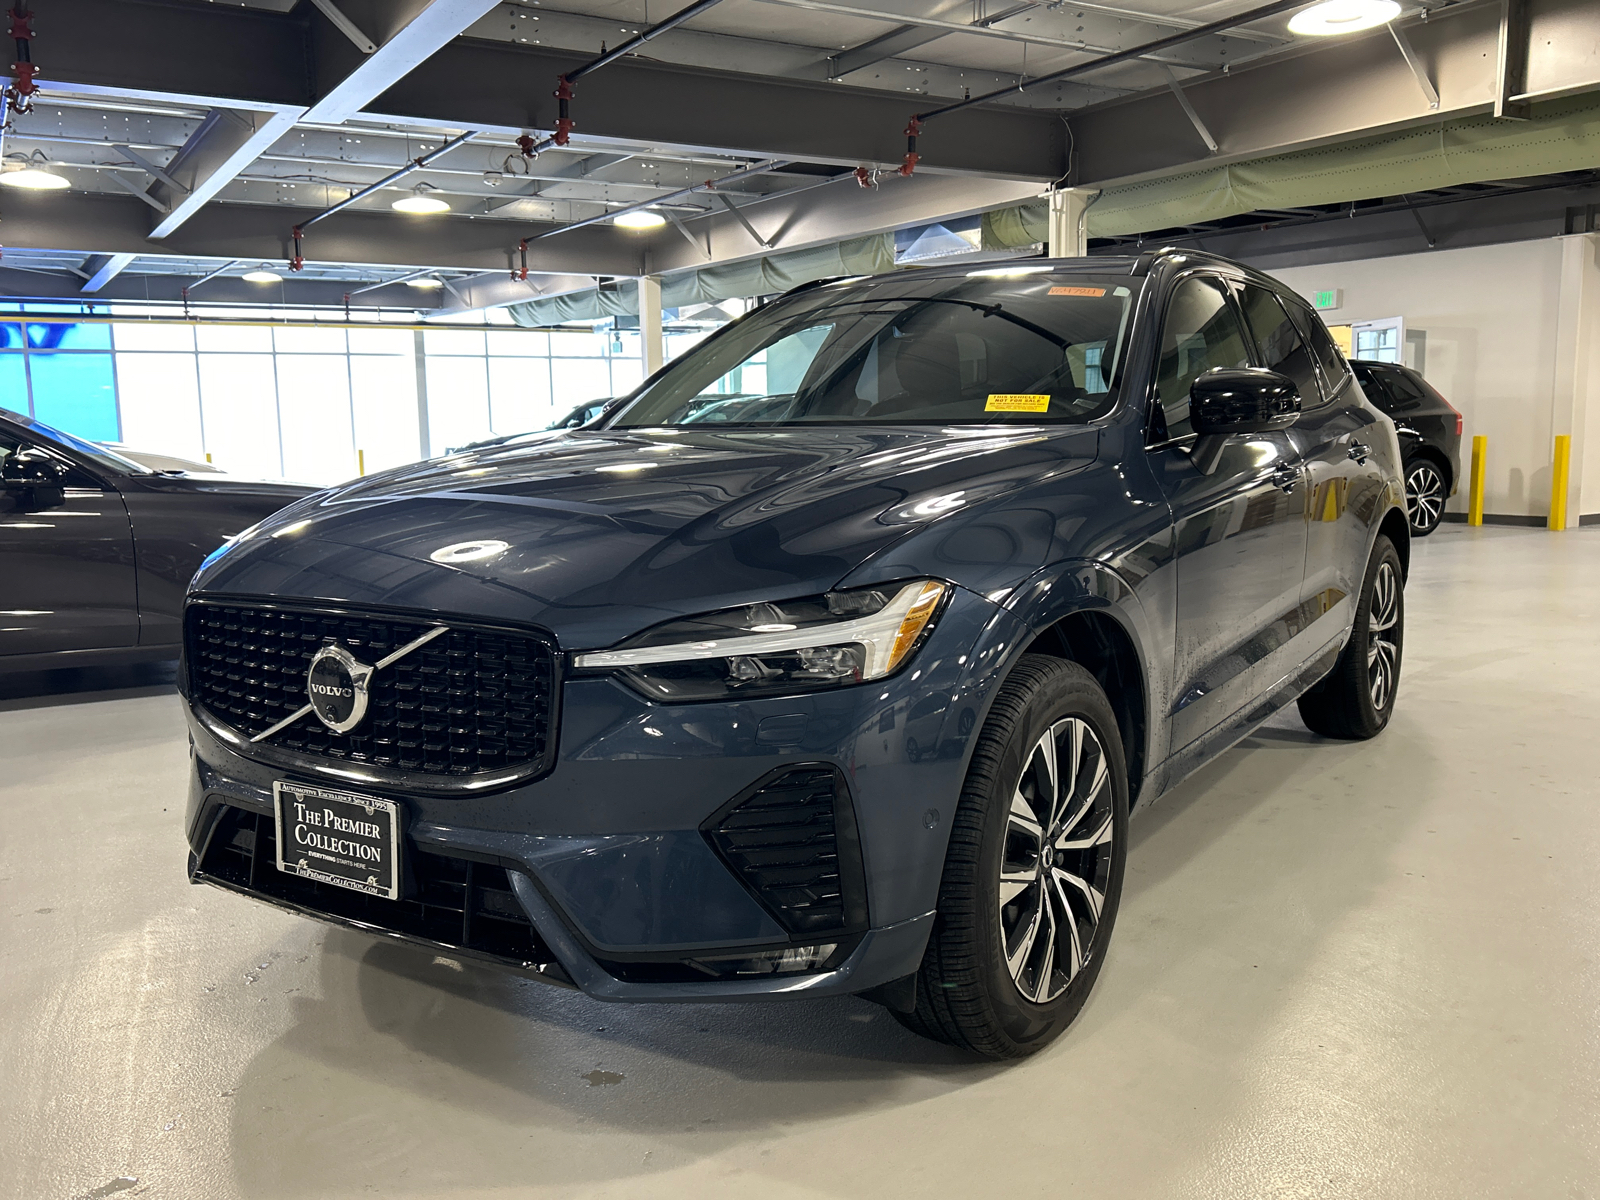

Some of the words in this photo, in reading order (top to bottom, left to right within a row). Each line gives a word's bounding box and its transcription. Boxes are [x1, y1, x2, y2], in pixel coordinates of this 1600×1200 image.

[1316, 291, 1334, 308] EXIT
[311, 683, 353, 698] VOLVO
[282, 784, 317, 796] AUTOMOTIVE
[371, 799, 388, 810] 1995
[293, 802, 322, 826] THE
[323, 808, 381, 839] PREMIER
[294, 824, 381, 863] COLLECTION
[308, 850, 336, 862] EVERYTHING
[336, 857, 353, 867] STARTS
[353, 862, 367, 870] HERE
